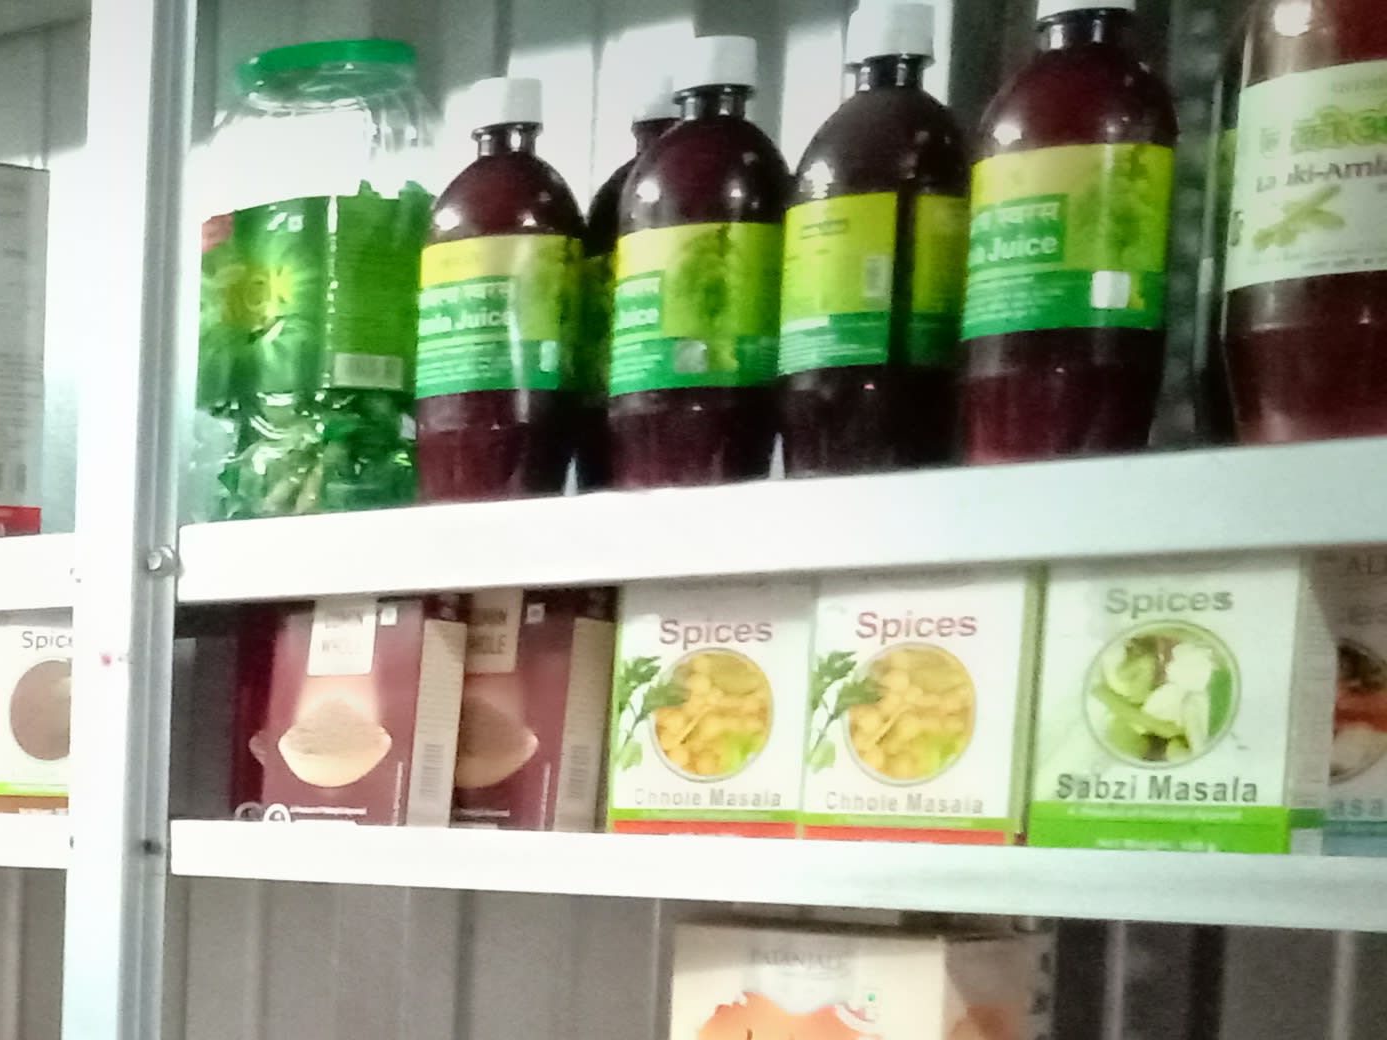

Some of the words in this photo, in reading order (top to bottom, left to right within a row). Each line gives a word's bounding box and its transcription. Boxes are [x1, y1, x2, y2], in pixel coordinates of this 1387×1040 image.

[987, 235, 1059, 263] Juice
[1104, 587, 1234, 619] Spices
[659, 618, 773, 651] Spices
[855, 611, 978, 645] Spices
[1056, 773, 1138, 800] Sabzi
[1147, 775, 1258, 803] Masala
